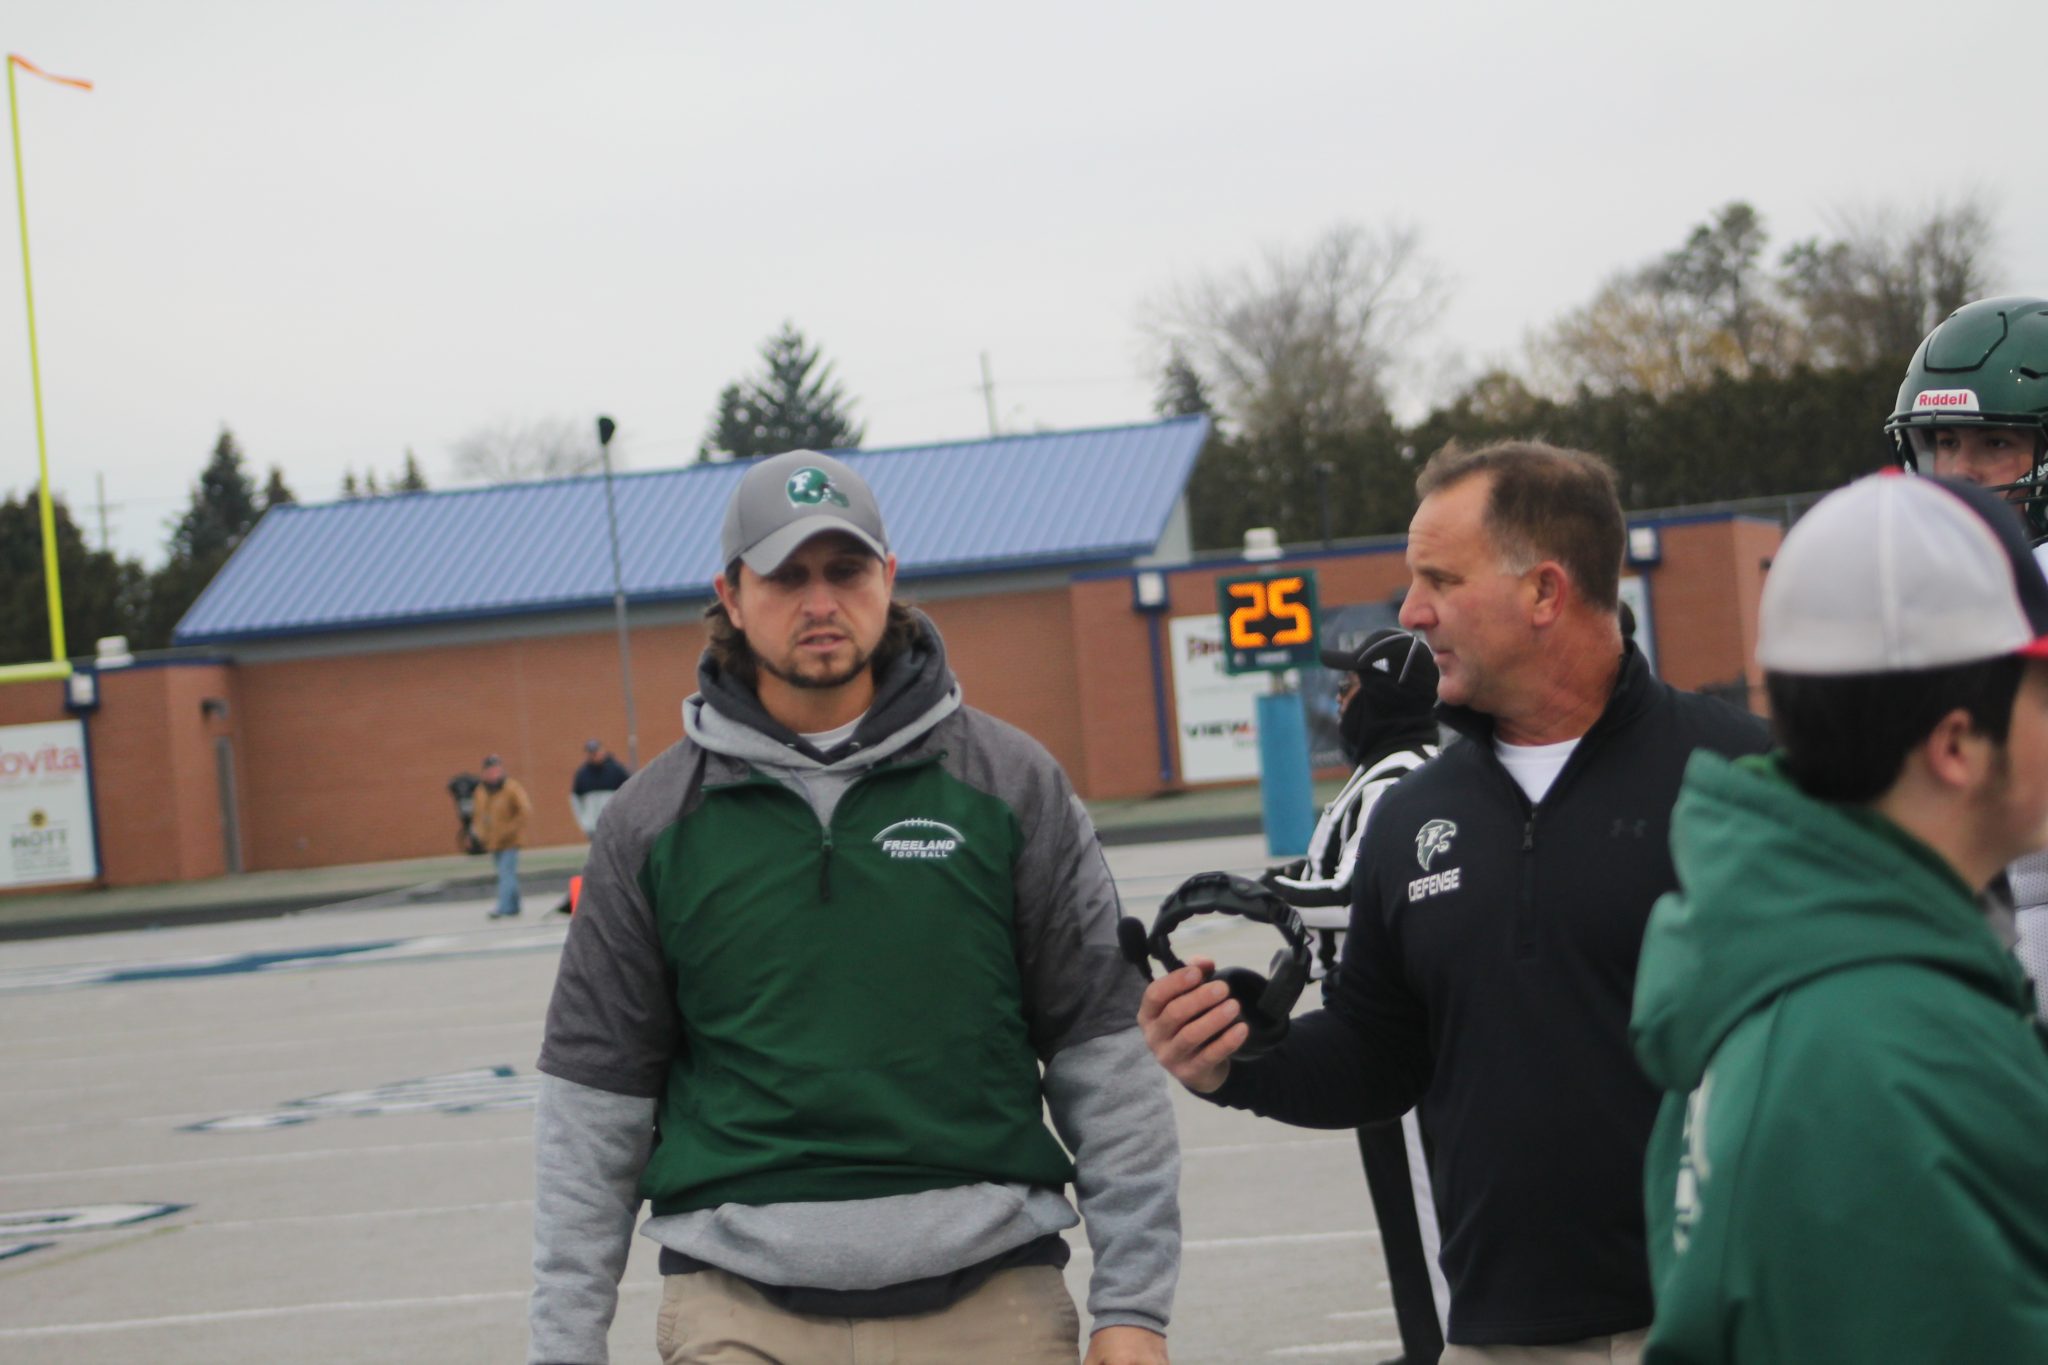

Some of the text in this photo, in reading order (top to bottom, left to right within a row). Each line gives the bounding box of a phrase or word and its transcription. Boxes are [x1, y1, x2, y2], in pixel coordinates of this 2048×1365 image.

[1919, 393, 1968, 406] Riddell
[1227, 576, 1312, 649] 25
[0, 742, 82, 774] ovita
[882, 840, 956, 851] FREELAND
[890, 850, 948, 858] FOOTBALL
[1408, 867, 1461, 902] DEFENSE
